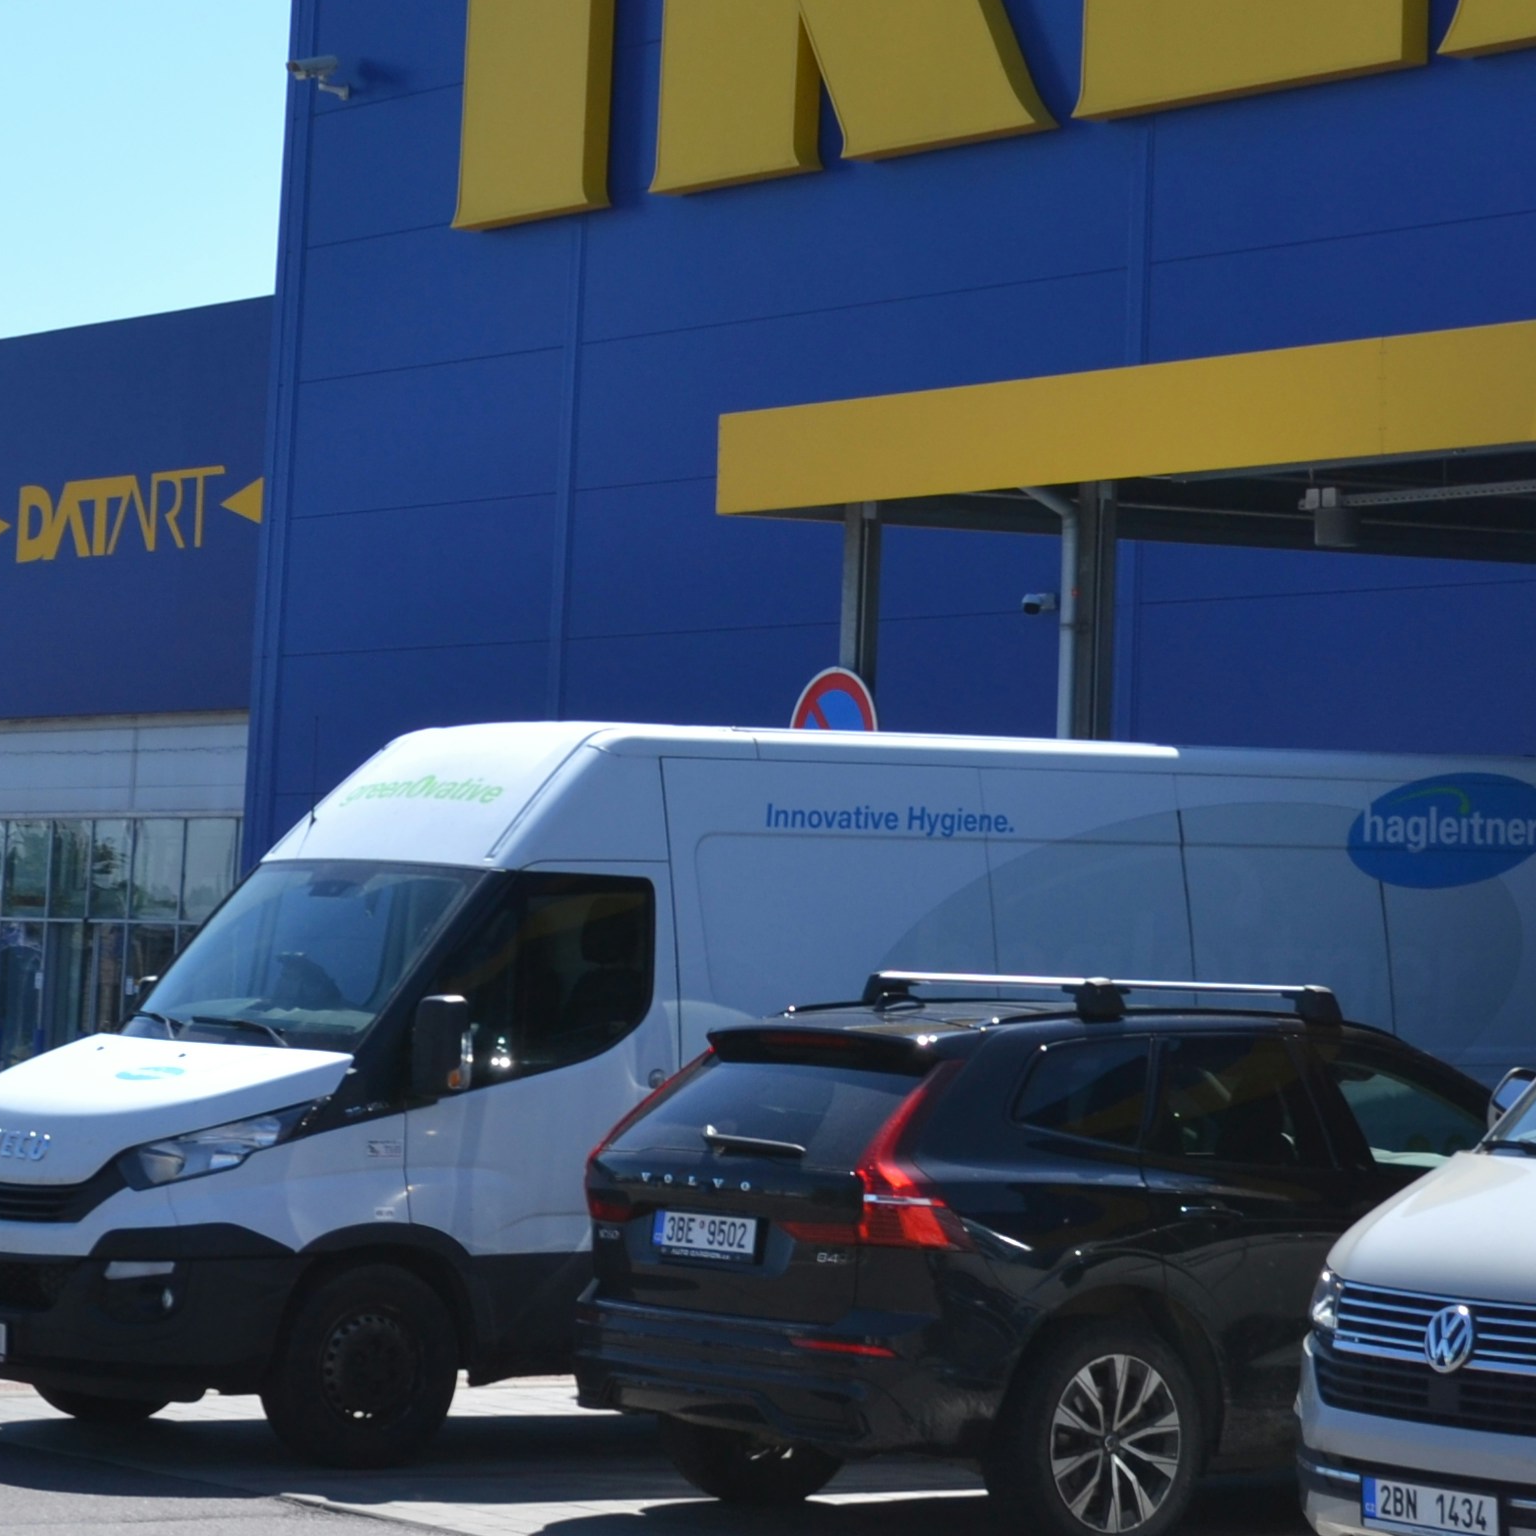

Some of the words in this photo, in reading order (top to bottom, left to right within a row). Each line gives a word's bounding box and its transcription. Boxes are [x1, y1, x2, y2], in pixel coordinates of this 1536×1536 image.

[16, 465, 226, 564] DATART
[766, 803, 899, 830] Innovative
[907, 805, 1015, 837] Hygiene.
[641, 1172, 752, 1191] VOLVO
[666, 1216, 695, 1244] 3BE
[706, 1220, 747, 1249] 9502
[1380, 1485, 1417, 1520] 2BN
[1435, 1494, 1487, 1531] 1434
